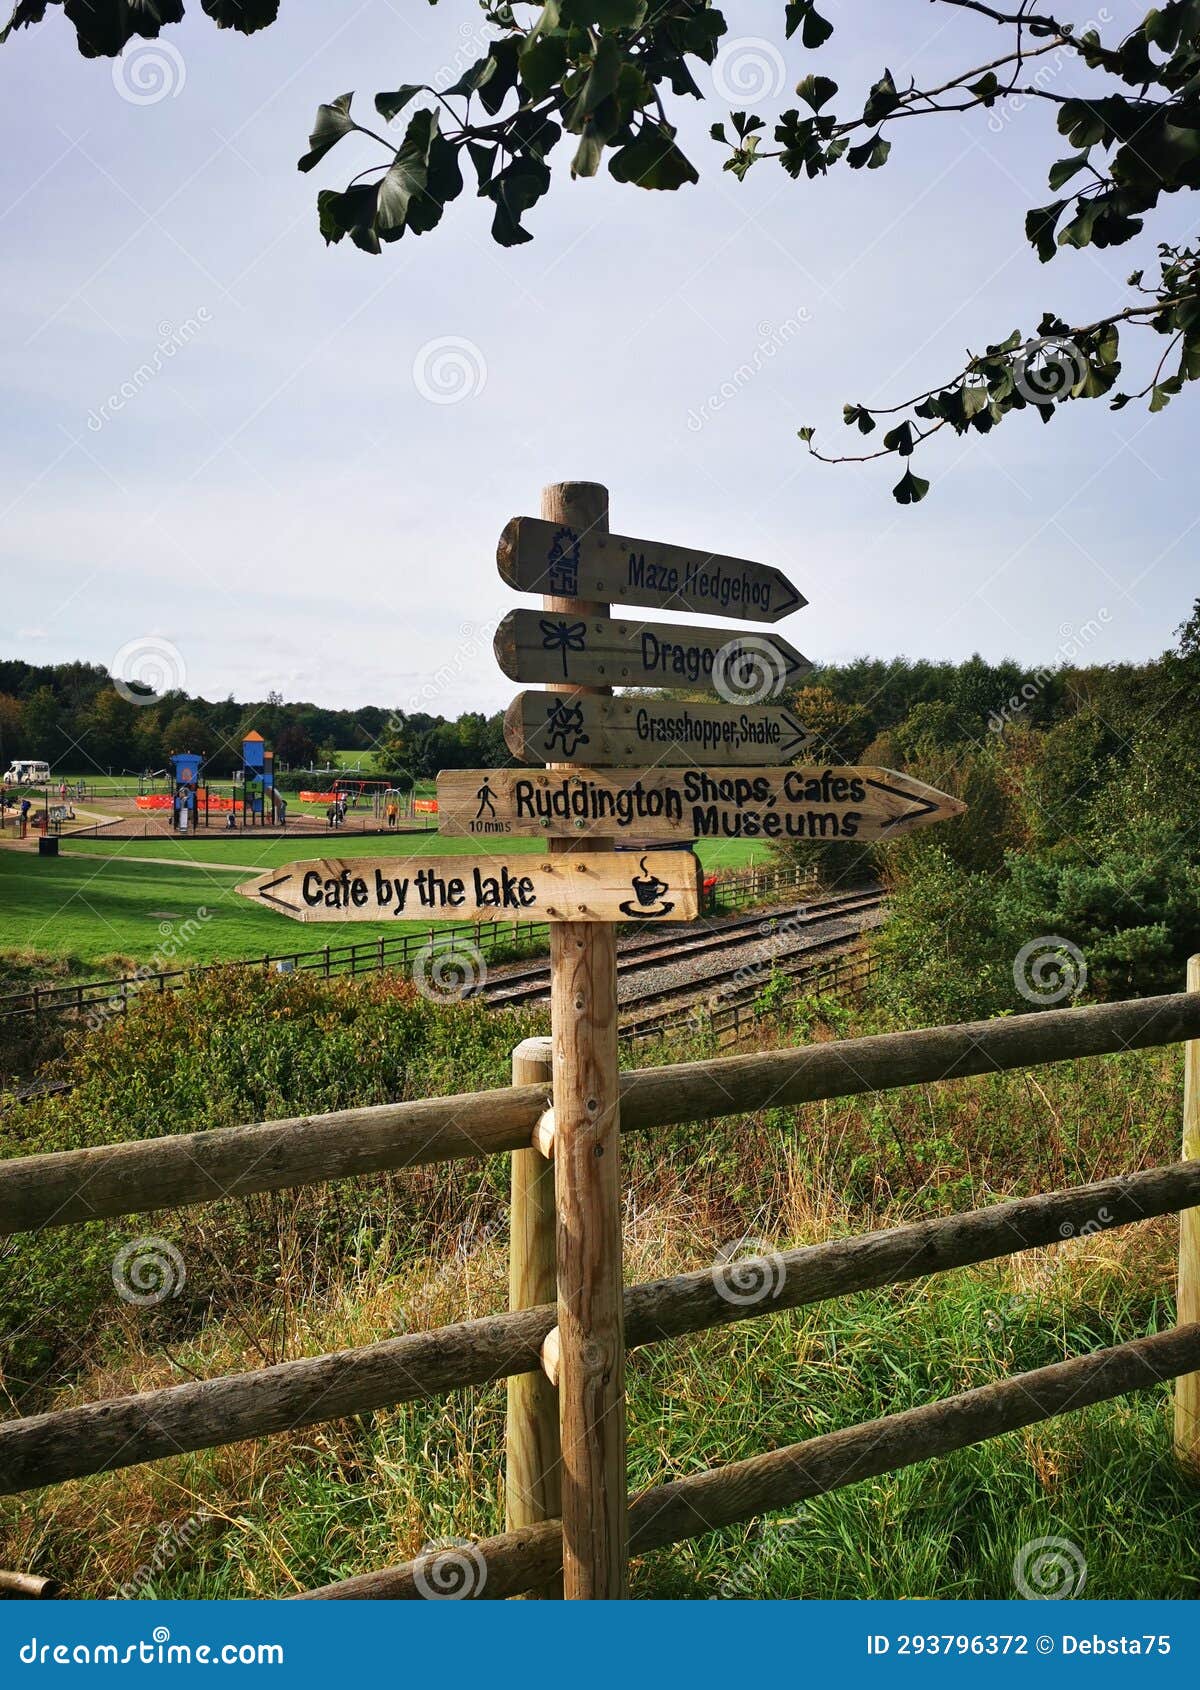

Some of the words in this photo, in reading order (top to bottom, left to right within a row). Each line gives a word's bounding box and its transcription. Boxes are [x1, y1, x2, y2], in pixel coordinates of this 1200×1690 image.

[516, 780, 682, 826] Ruddington
[684, 771, 776, 808] Shops,
[784, 772, 867, 802] Cafes
[692, 805, 862, 837] Museums
[302, 870, 369, 908] Cafe
[375, 868, 409, 915] by
[414, 868, 466, 908] the
[474, 866, 537, 908] lake
